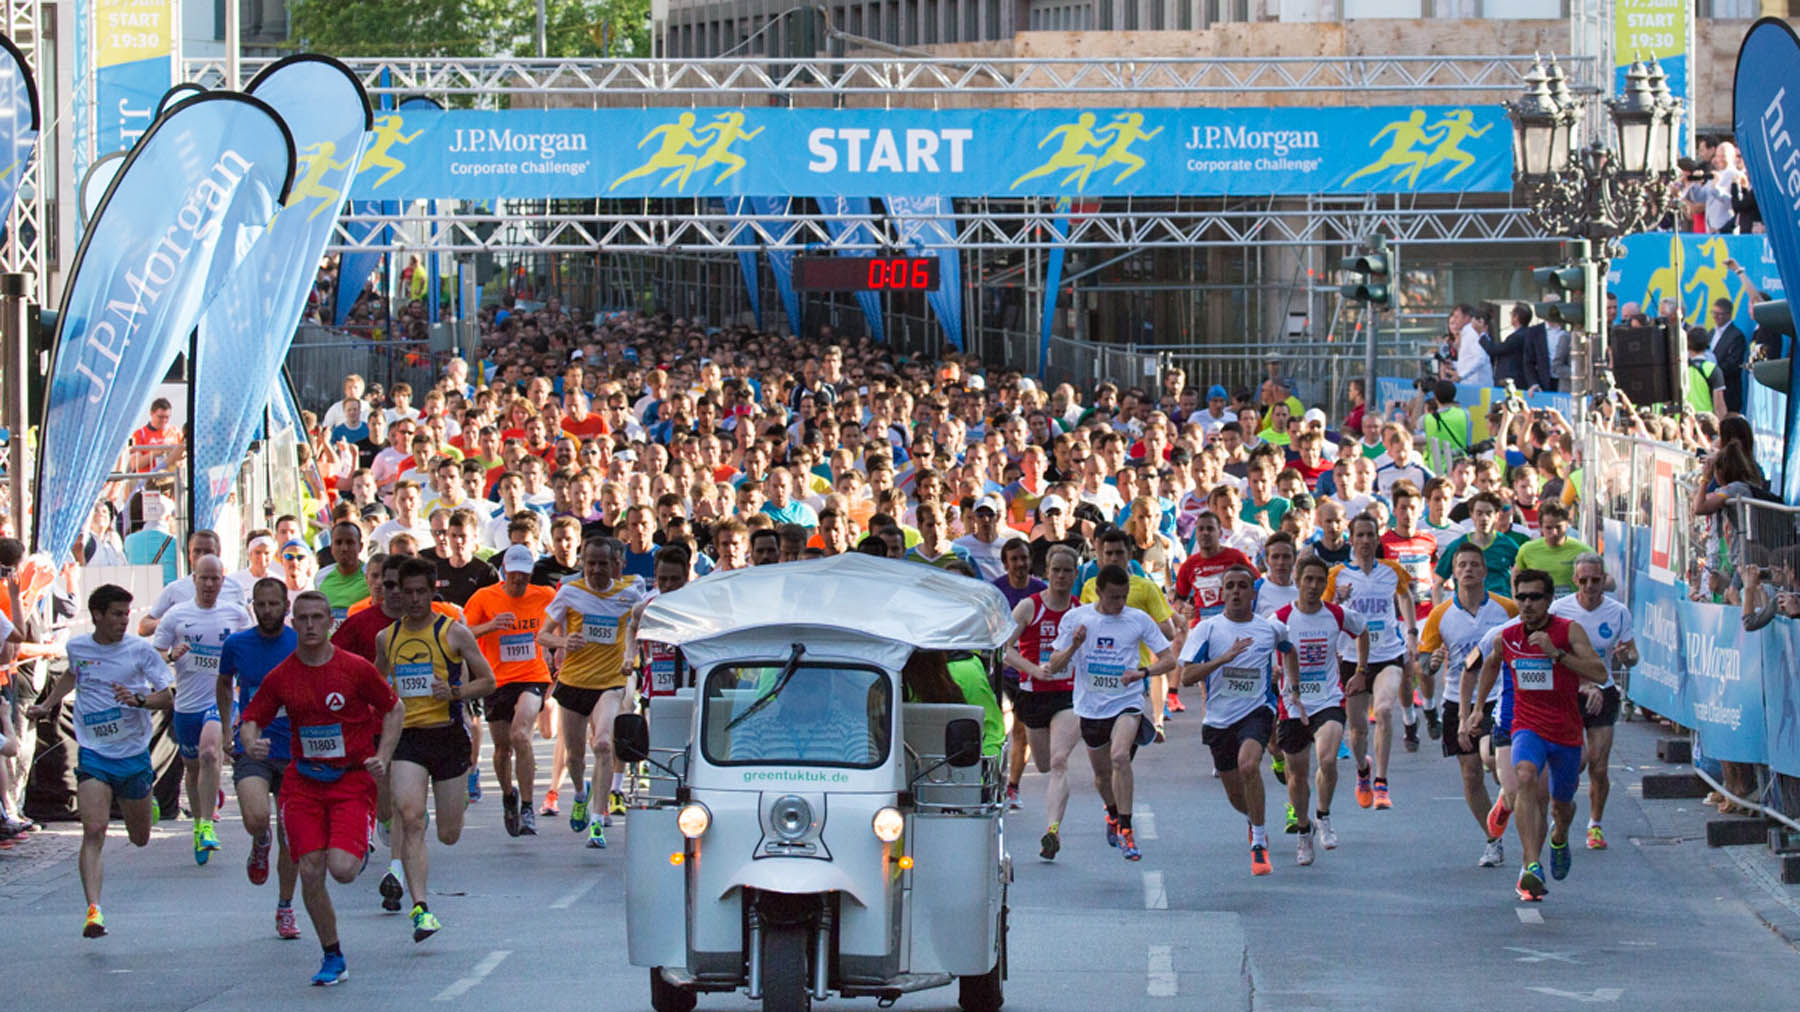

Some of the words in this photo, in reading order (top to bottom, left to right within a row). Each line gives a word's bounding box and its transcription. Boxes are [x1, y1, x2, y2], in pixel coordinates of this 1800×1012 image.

[109, 13, 160, 27] START
[1627, 13, 1676, 27] START
[112, 33, 159, 48] 19:30
[1630, 33, 1674, 48] 19:30
[448, 128, 587, 160] J.P.Morgan
[1185, 125, 1320, 157] J.P.Morgan
[807, 127, 974, 174] START
[450, 162, 518, 176] Corporate
[1187, 159, 1253, 173] Corporate
[868, 258, 929, 289] 0:06
[588, 626, 612, 639] 10535
[507, 645, 530, 656] 11911
[194, 655, 218, 669] 11558
[401, 676, 427, 690] 15392
[1093, 675, 1119, 689] 20152
[1521, 671, 1547, 683] 90008
[1228, 679, 1255, 692] 79607
[93, 722, 119, 739] 10243
[308, 738, 337, 752] 11803
[742, 770, 850, 784] greentuktuk.de
